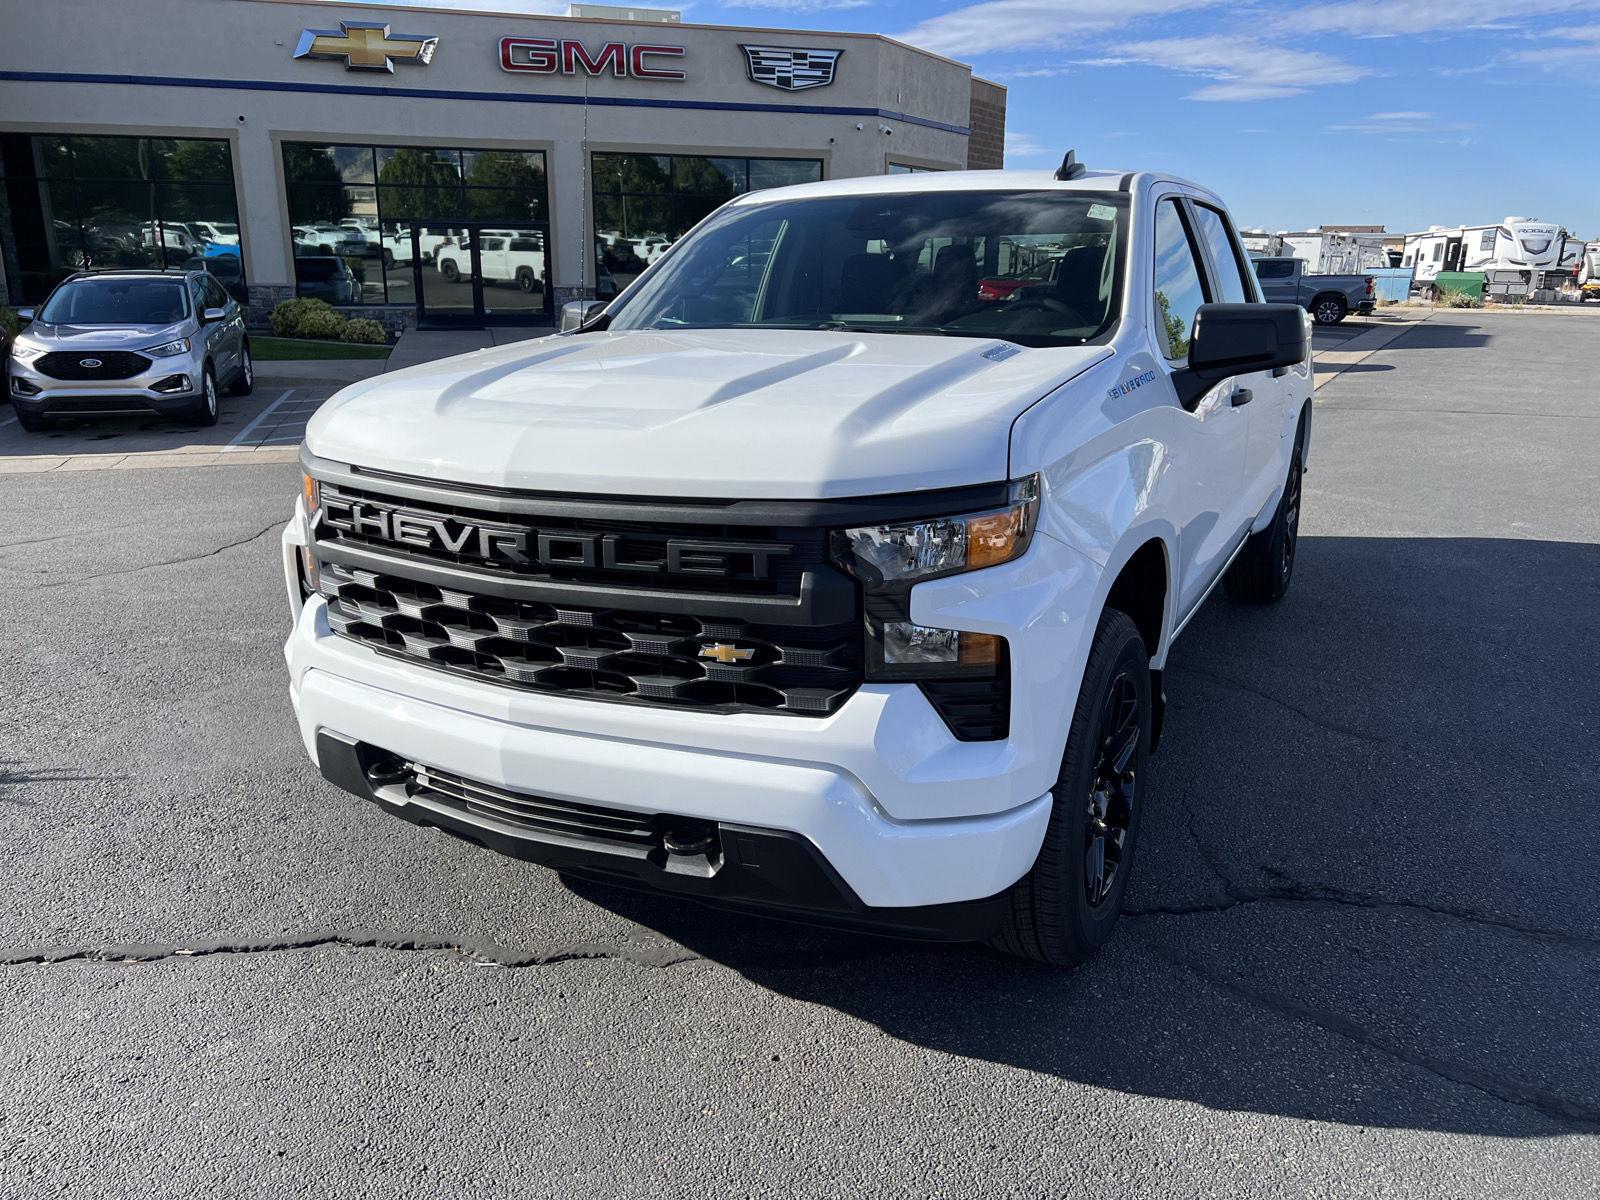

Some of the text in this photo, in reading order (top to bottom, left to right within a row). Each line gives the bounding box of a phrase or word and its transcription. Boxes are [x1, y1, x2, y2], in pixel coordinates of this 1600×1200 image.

[499, 36, 686, 80] GMC
[1108, 370, 1156, 400] SILVERADO
[320, 497, 797, 578] CHEVROLET
